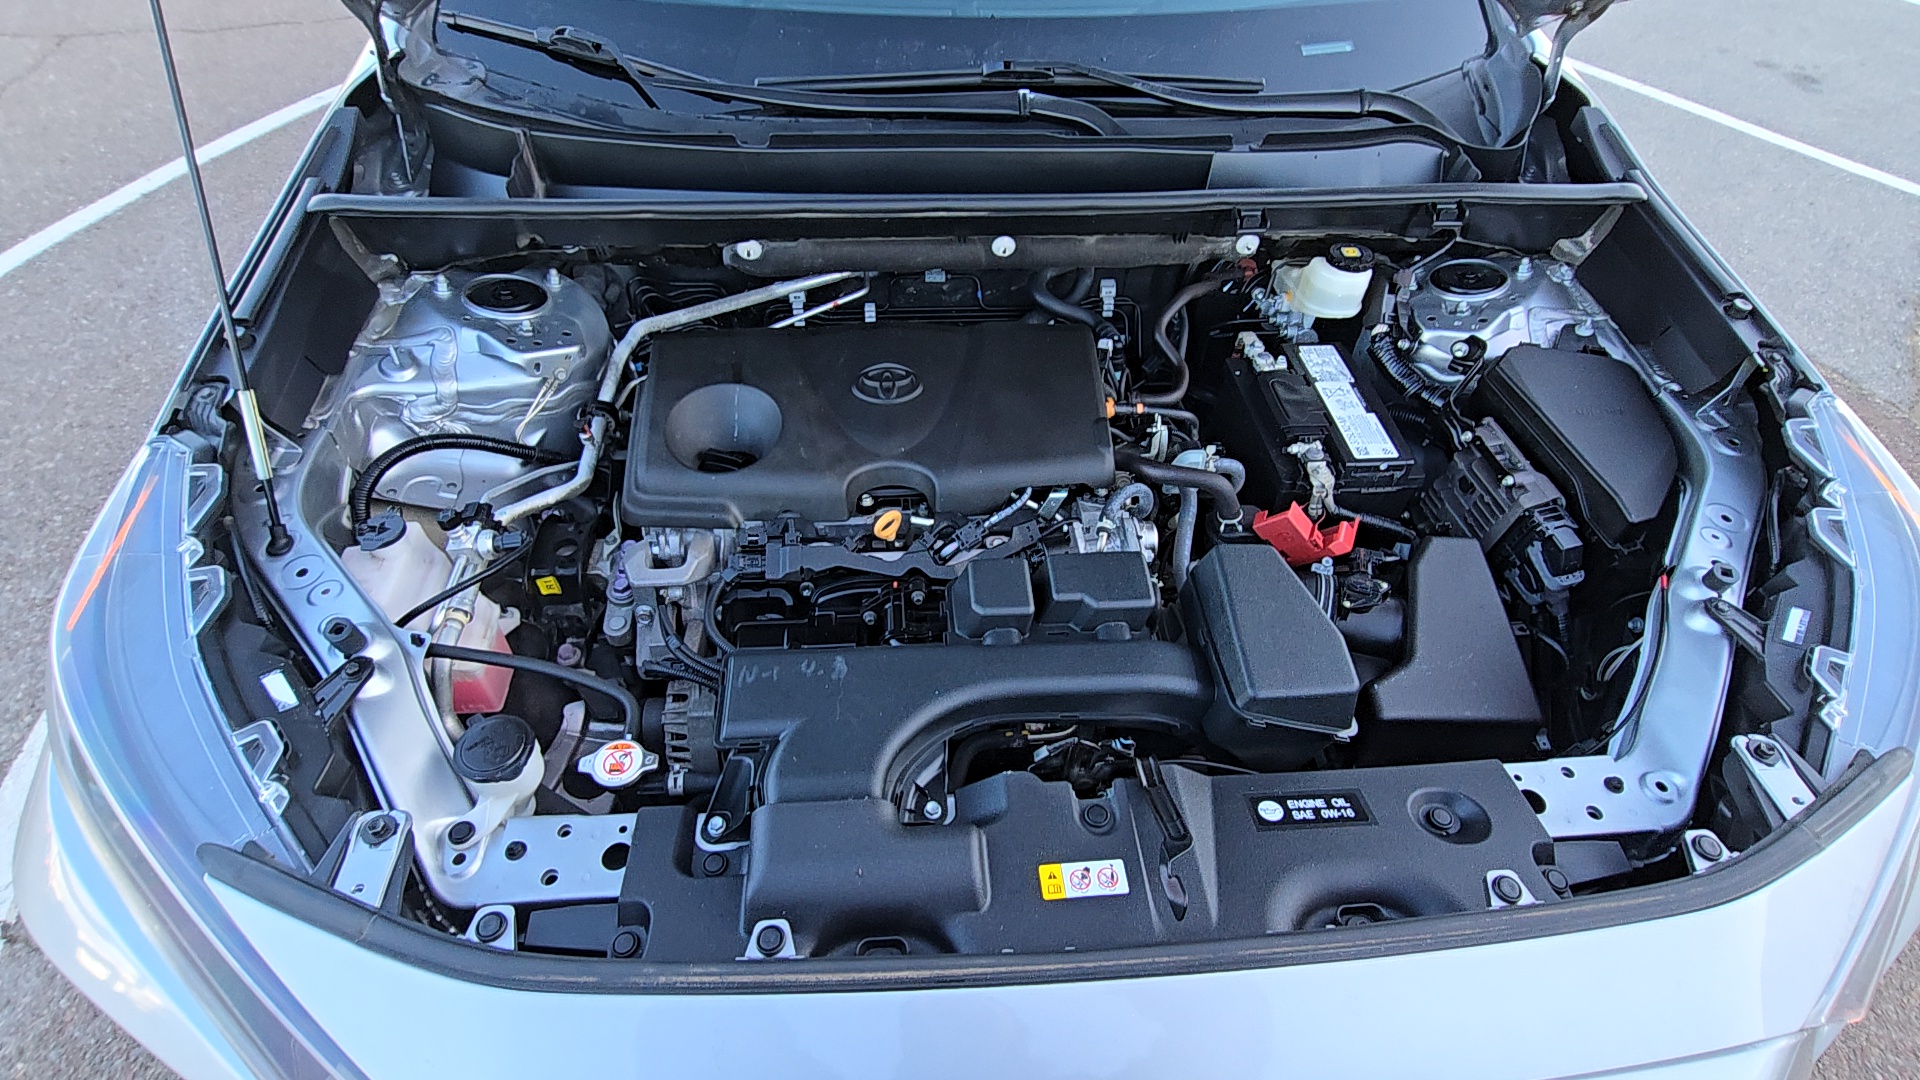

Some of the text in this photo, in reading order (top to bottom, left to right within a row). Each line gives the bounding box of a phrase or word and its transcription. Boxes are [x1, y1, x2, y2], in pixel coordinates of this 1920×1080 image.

[1286, 797, 1351, 810] ENGINE OIL
[1291, 808, 1356, 820] SAE 0W-16
